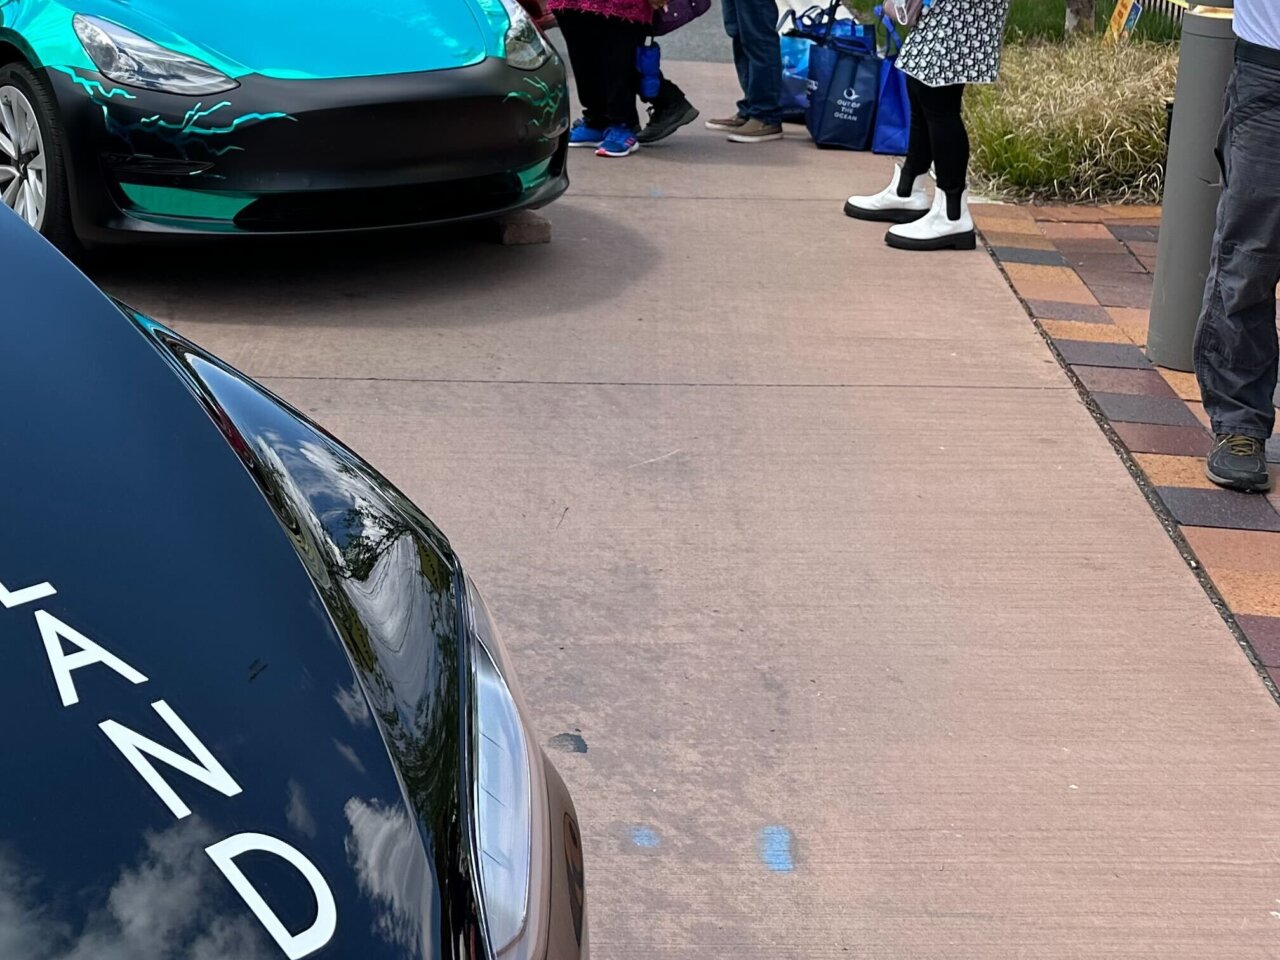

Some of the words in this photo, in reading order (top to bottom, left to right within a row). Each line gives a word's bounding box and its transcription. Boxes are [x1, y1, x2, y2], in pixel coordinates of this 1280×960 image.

[837, 99, 851, 107] OUT
[841, 106, 854, 115] THE
[833, 111, 858, 121] OCEAN
